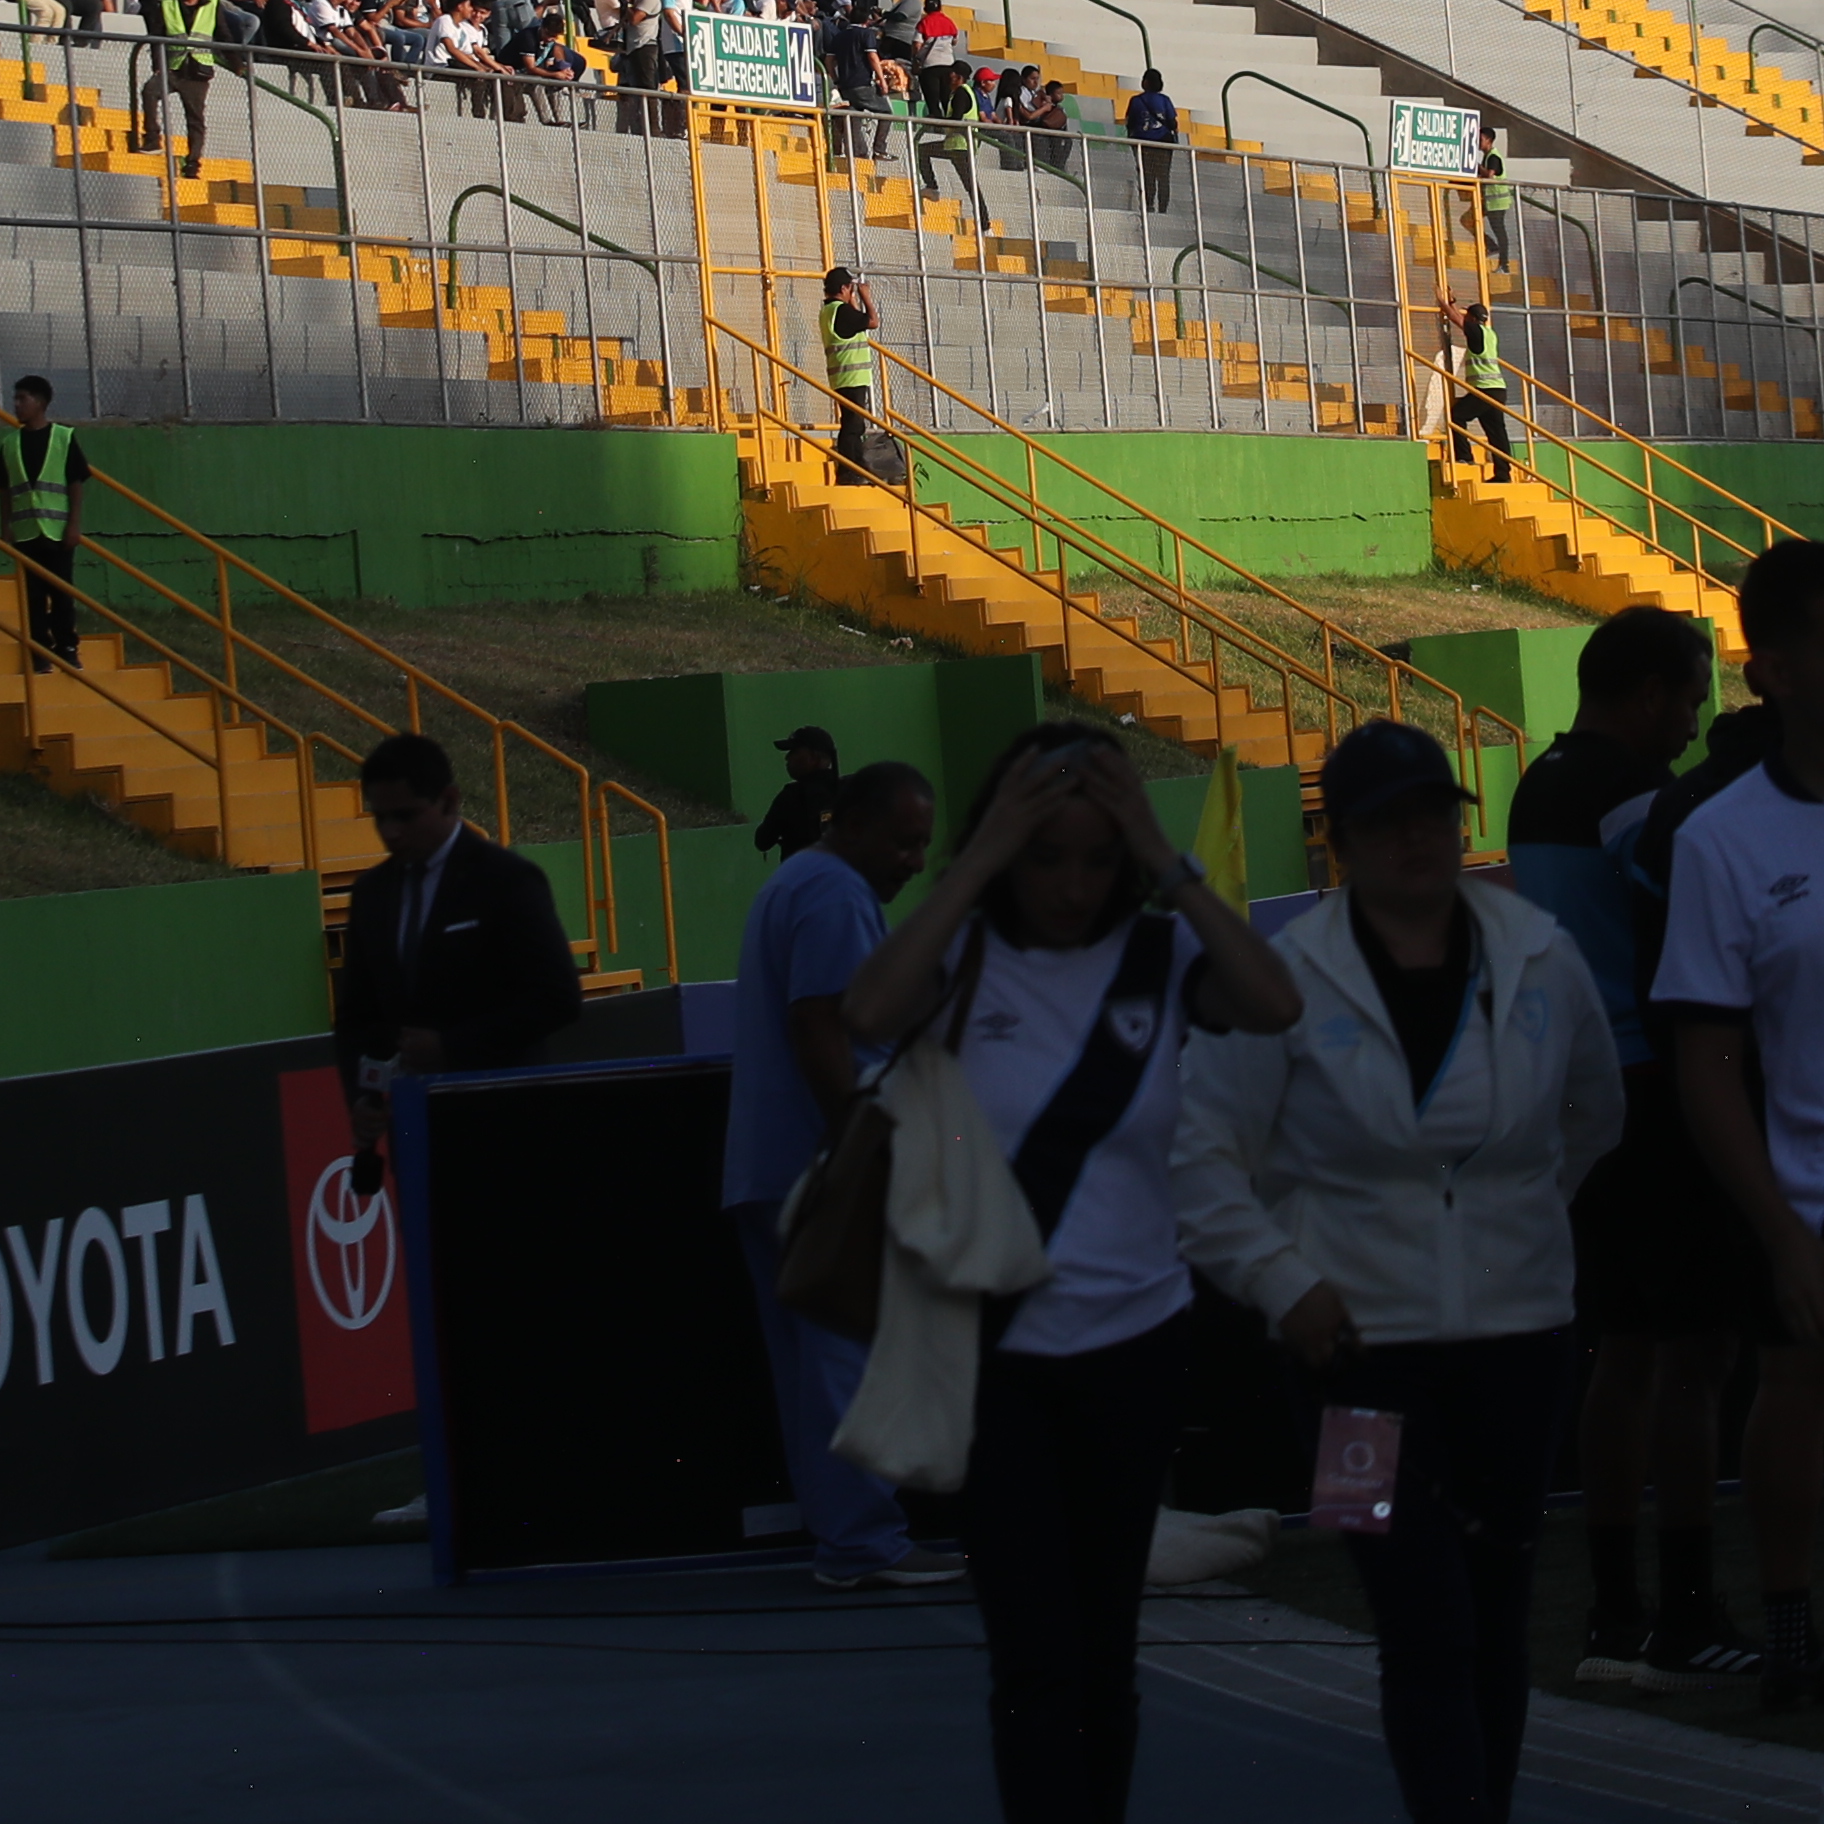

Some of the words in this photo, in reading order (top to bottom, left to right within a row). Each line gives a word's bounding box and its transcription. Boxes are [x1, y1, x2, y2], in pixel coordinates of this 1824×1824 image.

[721, 22, 764, 57] SALIDA
[763, 28, 780, 59] DE
[716, 60, 790, 96] EMERGENCIA
[790, 32, 814, 96] 14
[1417, 110, 1445, 138] SALIDA
[1446, 114, 1457, 139] DE
[1411, 140, 1460, 168] EMERGENCIA
[1462, 117, 1478, 170] 13
